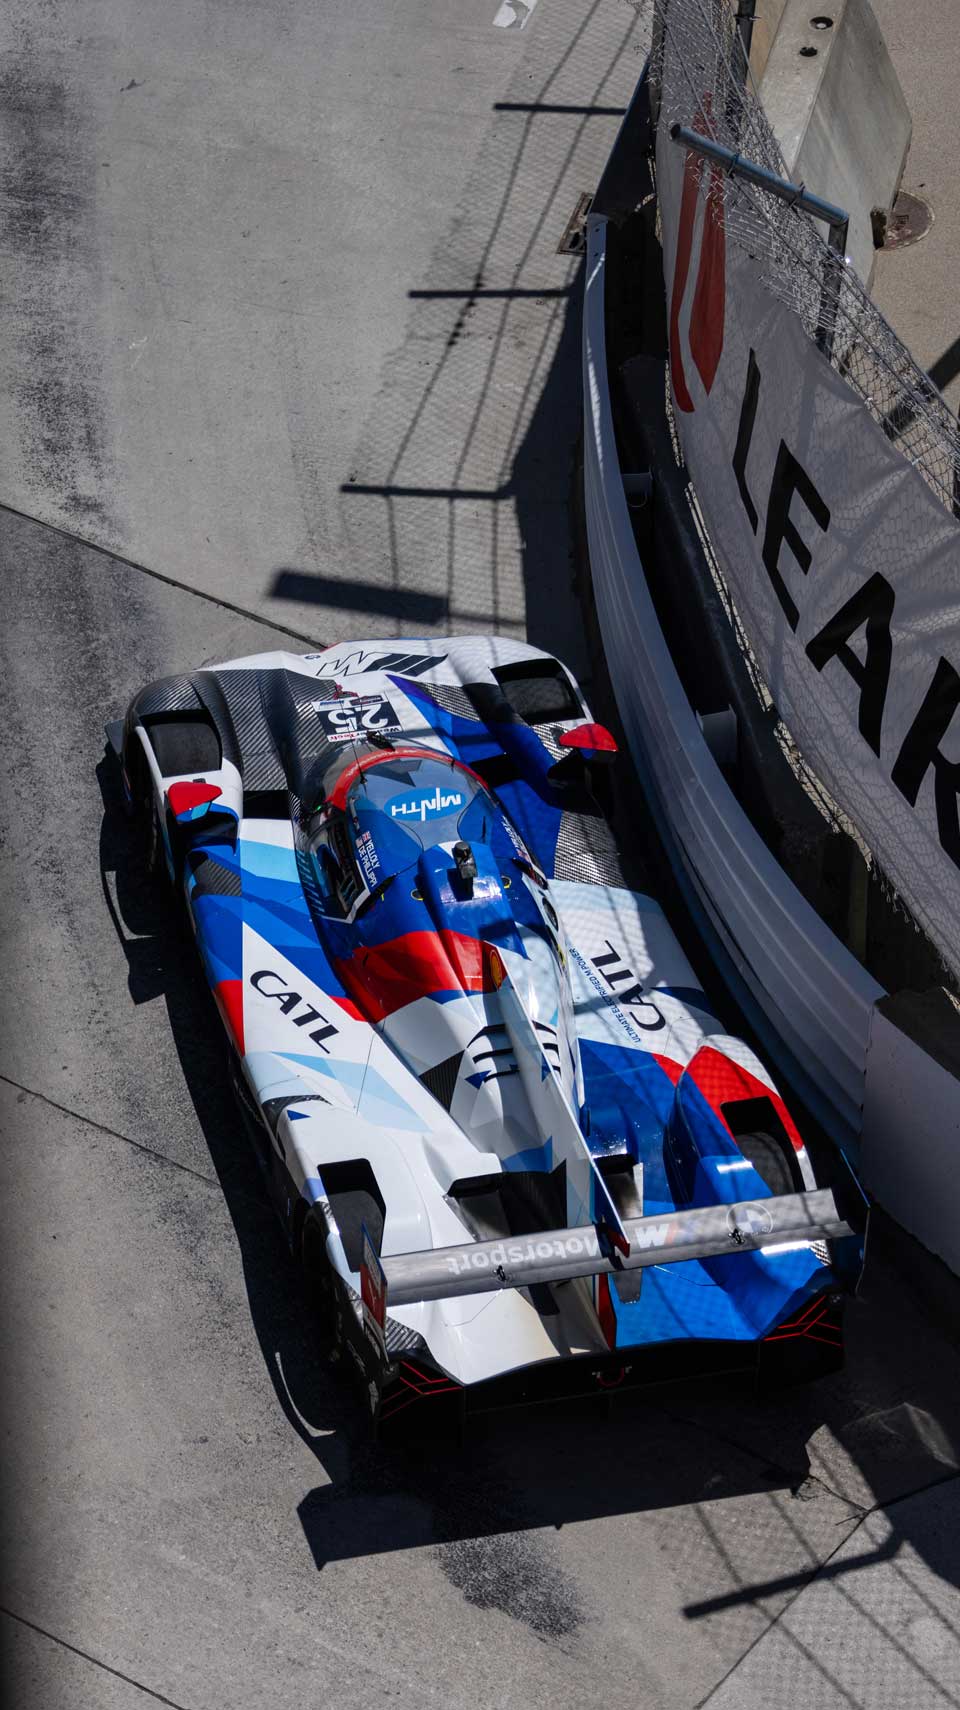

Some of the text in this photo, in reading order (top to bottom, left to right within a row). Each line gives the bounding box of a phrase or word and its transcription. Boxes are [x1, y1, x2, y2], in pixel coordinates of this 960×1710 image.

[327, 704, 389, 734] 25
[330, 727, 400, 741] WeaerTech
[391, 787, 461, 822] MINTH
[358, 845, 378, 888] DE PHILLIPPI
[365, 839, 380, 869] YELLOLY
[569, 948, 587, 970] POWER
[589, 976, 620, 1014] ELECTRIFIED
[590, 940, 666, 1031] CATL
[250, 970, 339, 1054] CATL
[615, 1012, 641, 1043] ULTIMATE
